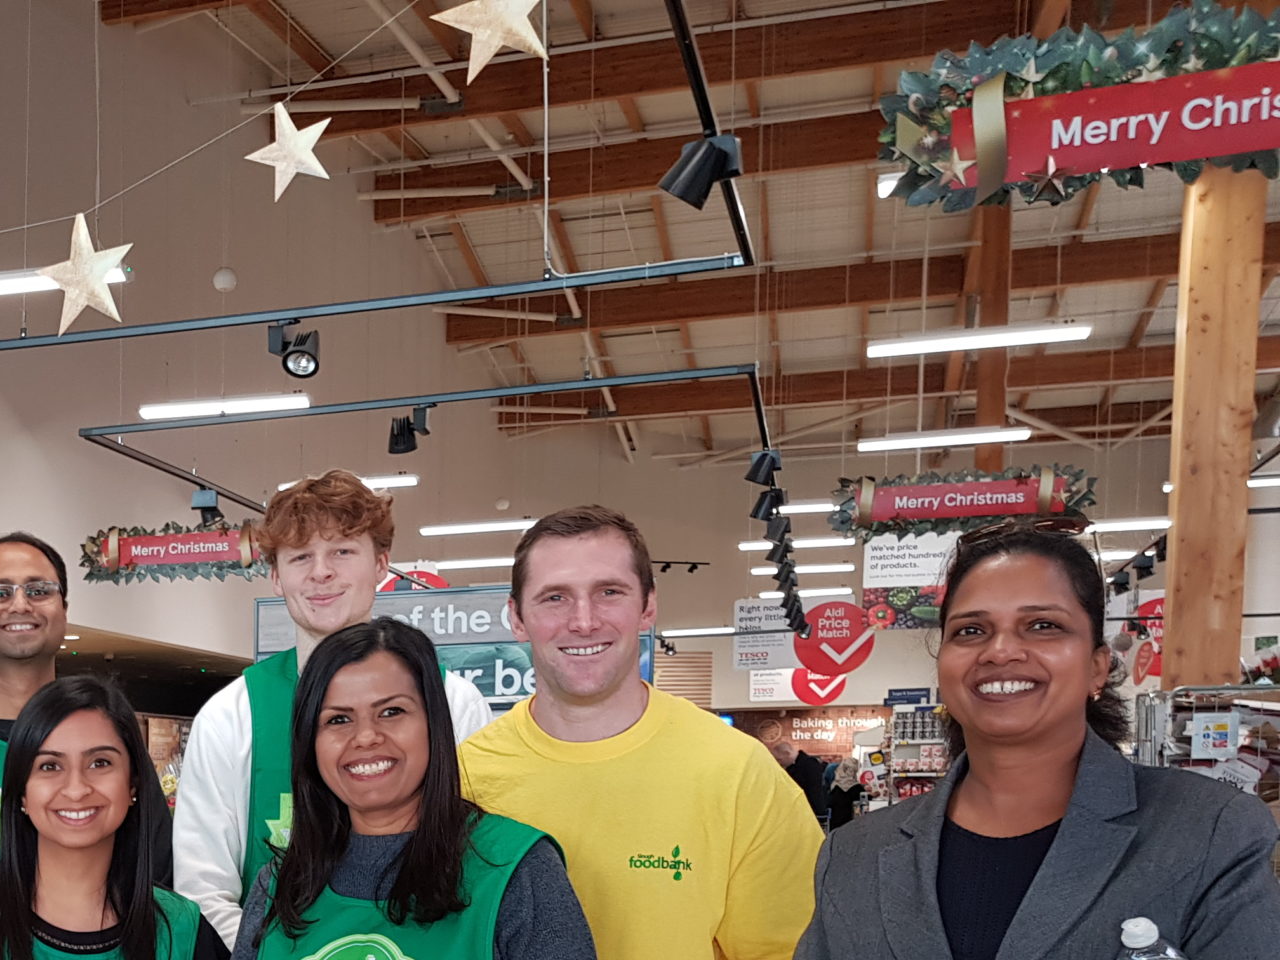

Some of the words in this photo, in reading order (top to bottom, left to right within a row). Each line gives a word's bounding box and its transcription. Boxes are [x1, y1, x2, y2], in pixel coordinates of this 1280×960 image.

[1051, 111, 1170, 150] Merry
[895, 496, 941, 510] Merry
[944, 492, 1025, 506] Christmas
[131, 544, 166, 558] Merry
[169, 541, 229, 554] Christmas
[870, 544, 895, 552] We've
[897, 543, 918, 552] price
[870, 553, 906, 561] matched
[870, 562, 879, 570] of
[880, 561, 920, 571] products.
[739, 605, 761, 614] Right
[824, 608, 845, 618] Aldi
[430, 603, 491, 635] the
[739, 615, 763, 623] every
[764, 613, 785, 621] little
[817, 618, 850, 628] Price
[817, 628, 850, 638] Match
[738, 651, 768, 660] TESCO
[792, 717, 834, 730] Baking
[838, 716, 886, 728] through
[791, 730, 812, 740] the
[813, 730, 836, 741] day
[628, 855, 693, 871] foodbank
